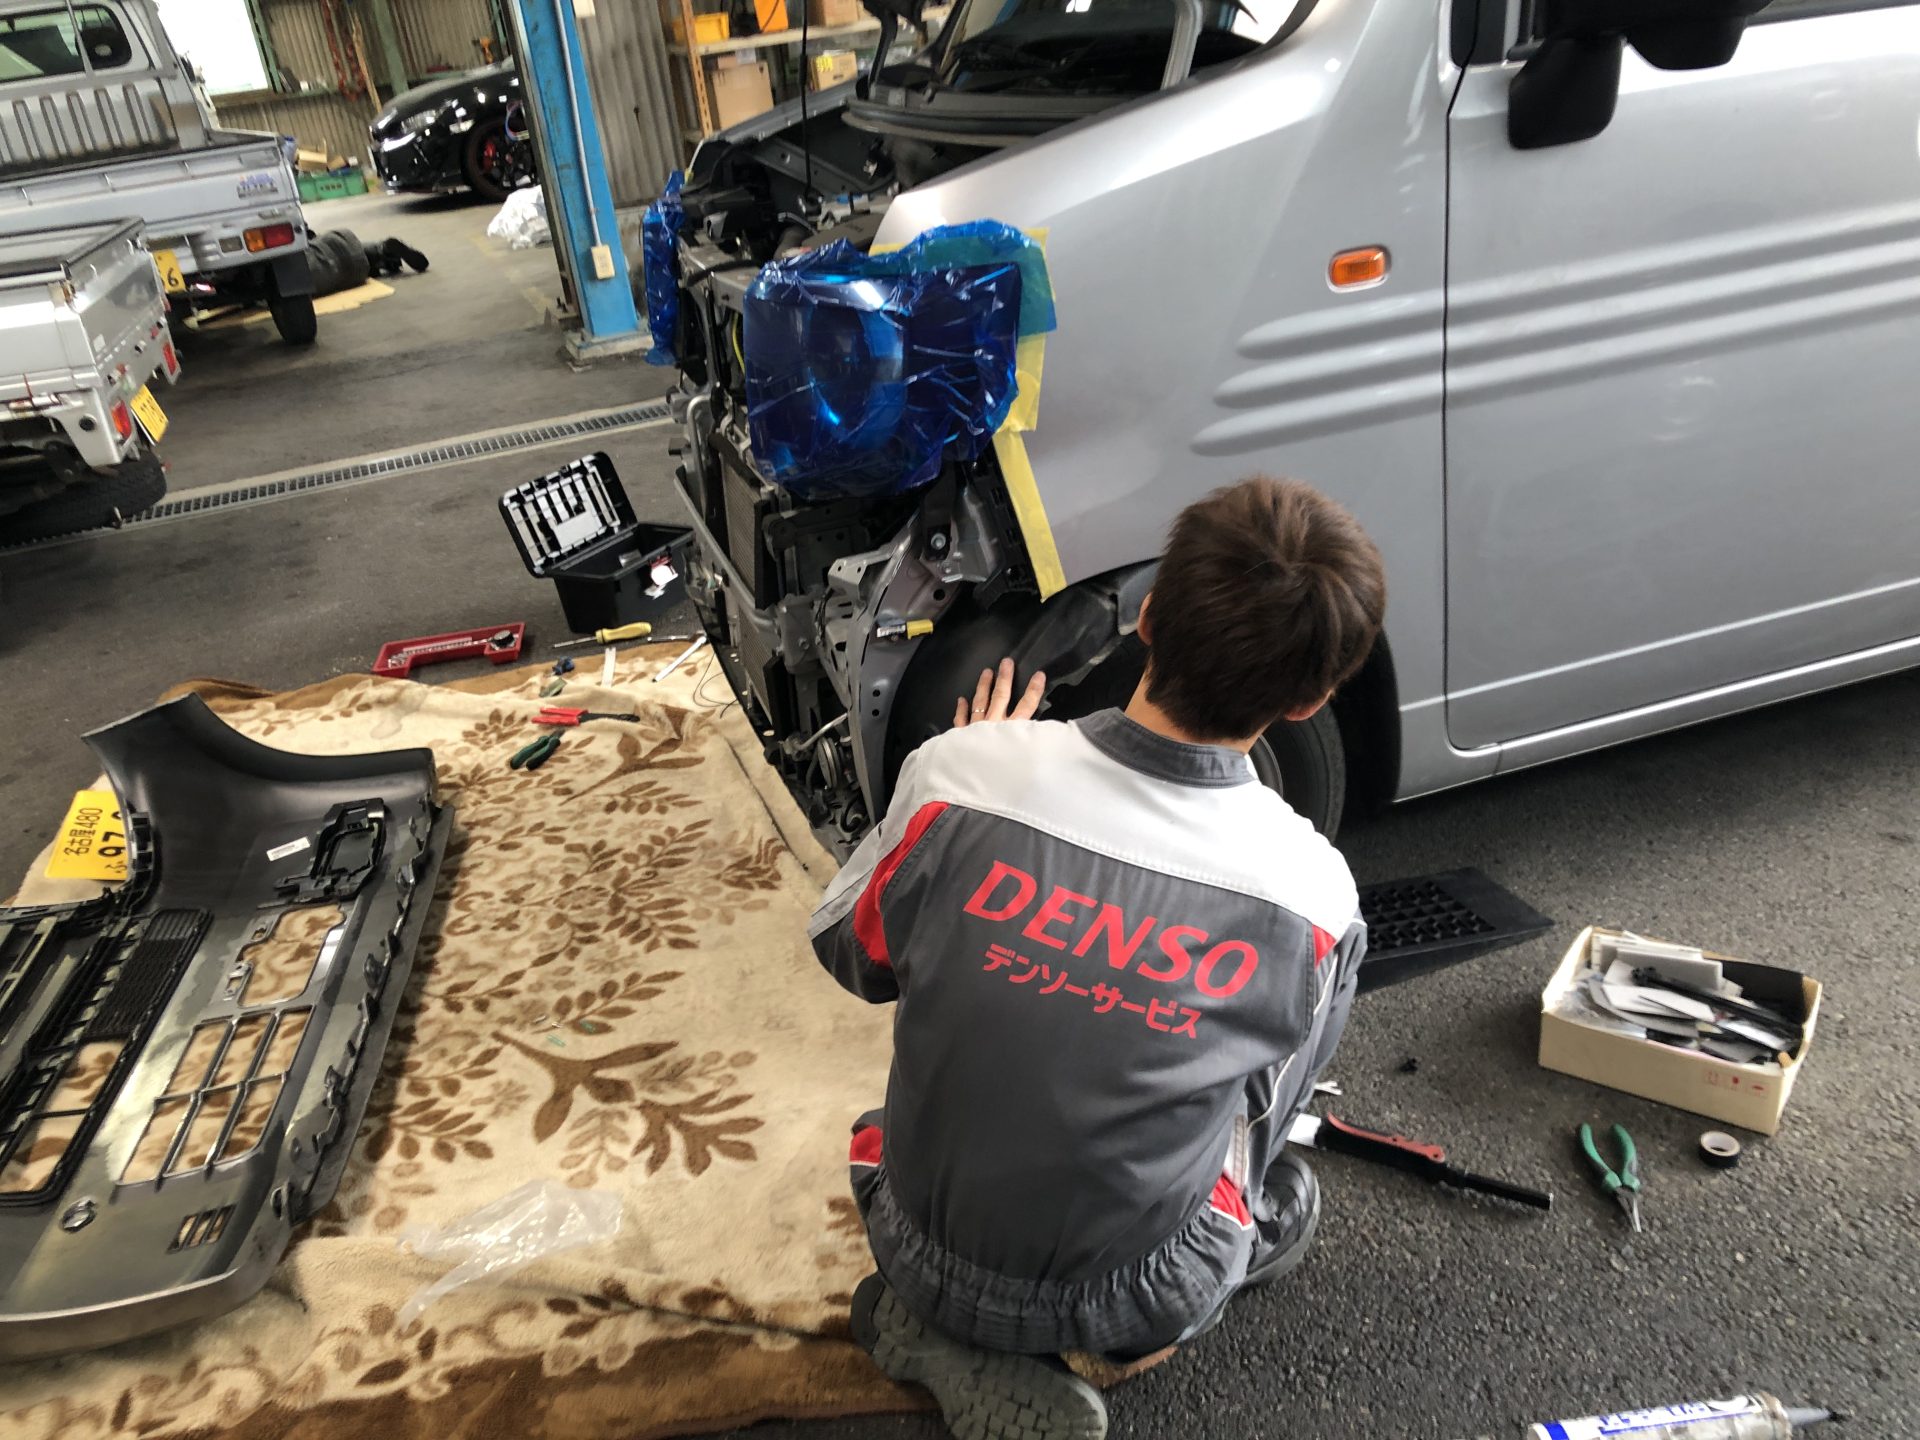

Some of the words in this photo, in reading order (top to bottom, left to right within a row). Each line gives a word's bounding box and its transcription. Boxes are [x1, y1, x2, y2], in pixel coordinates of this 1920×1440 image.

[963, 860, 1259, 999] DENSO
[983, 943, 1202, 1039] デンソーサービス
